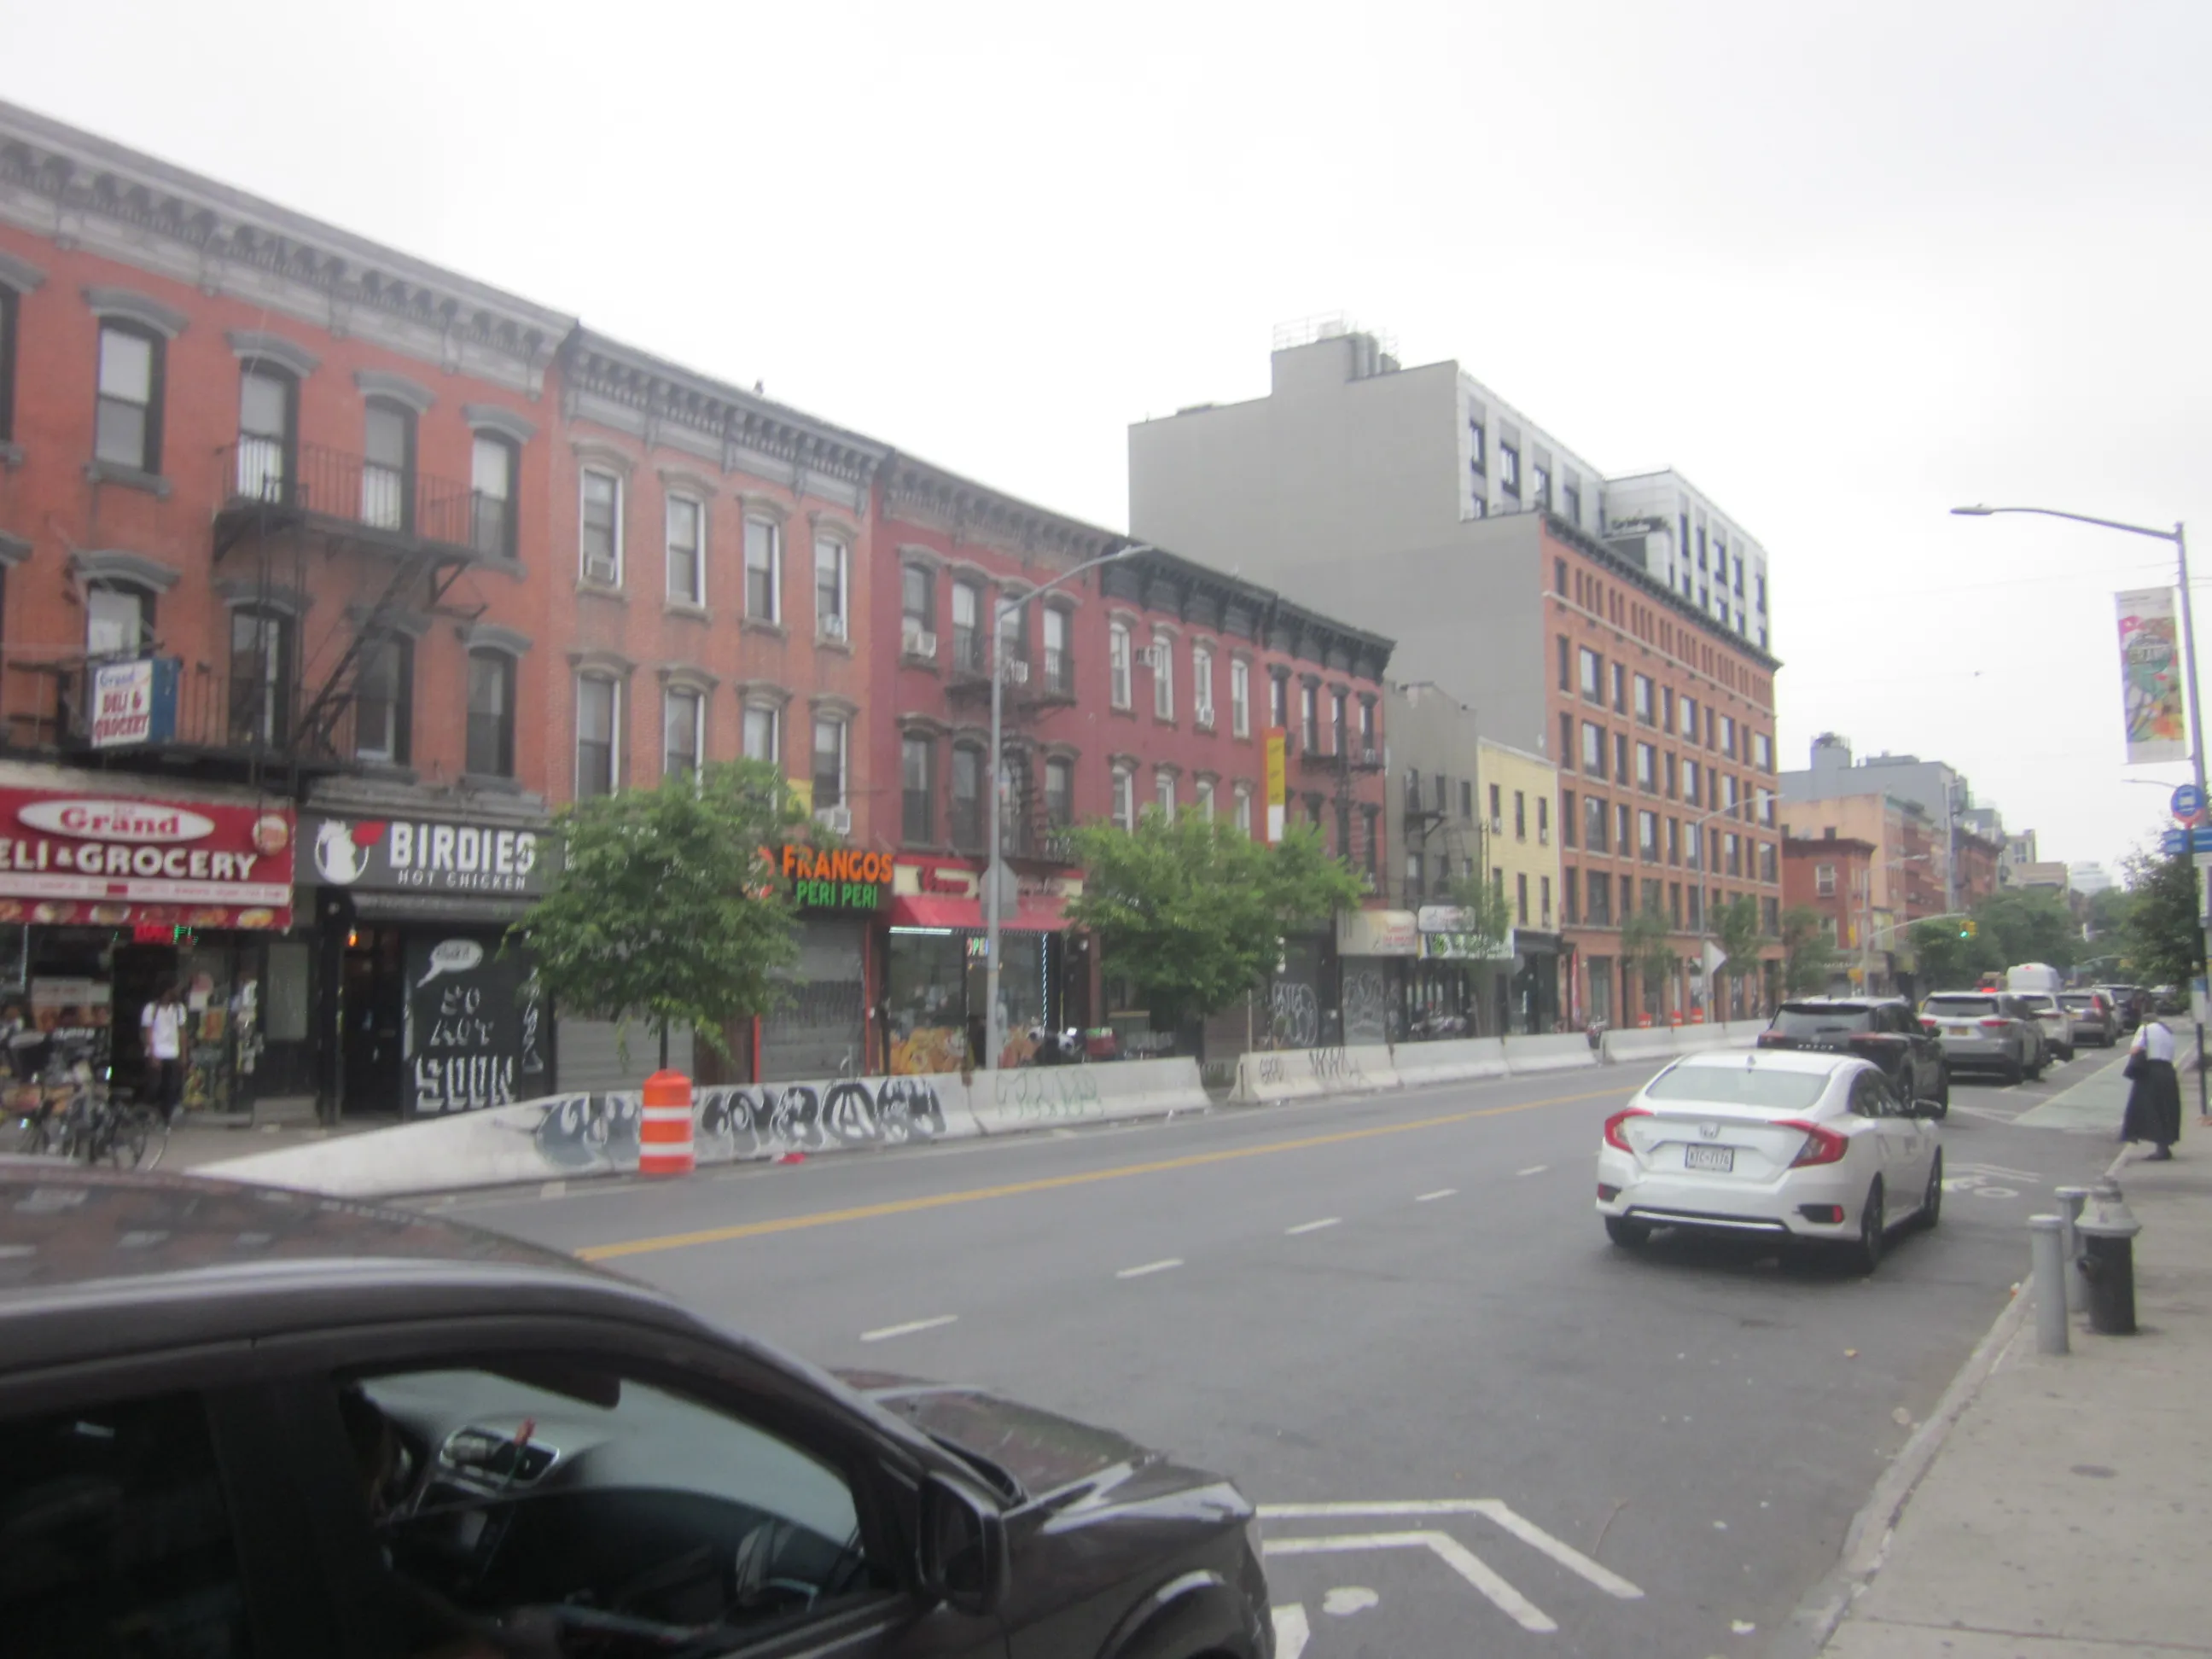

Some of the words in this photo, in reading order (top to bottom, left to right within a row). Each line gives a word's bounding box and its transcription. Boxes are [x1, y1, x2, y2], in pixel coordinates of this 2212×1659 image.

[103, 692, 128, 713] DELI
[94, 714, 148, 740] GROCERY
[59, 806, 180, 835] Grand
[55, 846, 72, 867] &
[75, 842, 257, 881] GROCERY
[389, 821, 537, 875] BIRDIES
[398, 869, 435, 886] HOT
[445, 873, 526, 890] CHICKEN
[796, 880, 836, 906] PERI
[841, 882, 878, 909] PERI
